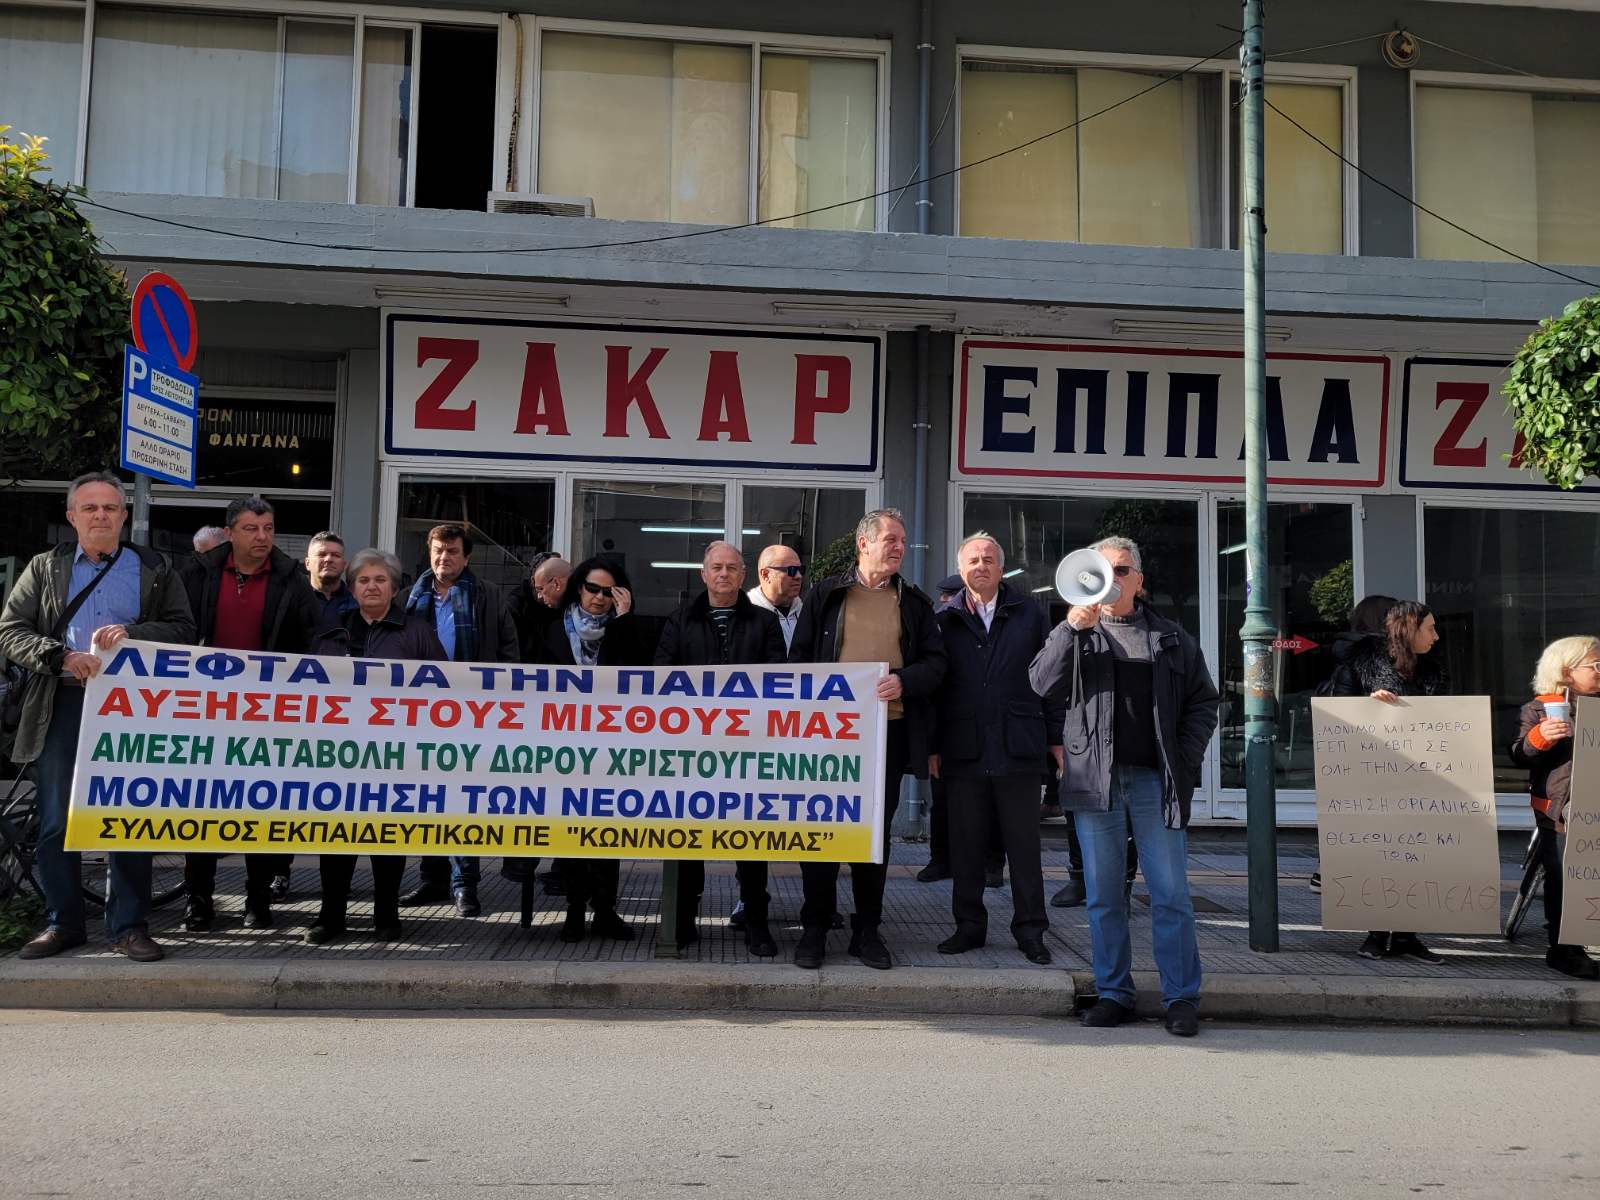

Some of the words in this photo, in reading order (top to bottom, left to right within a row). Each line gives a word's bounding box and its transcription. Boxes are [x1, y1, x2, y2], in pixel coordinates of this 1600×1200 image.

[128, 353, 148, 390] P
[151, 371, 194, 398] ΤΡΟΦΟΔΟΣΙΑ
[414, 336, 852, 445] ΖΑΚΑΡ
[980, 364, 1361, 464] ΕΠΙΠΛΑ
[140, 439, 158, 453] ΑΛΛΟ
[159, 445, 181, 460] ΩΡΑΡΙΟ
[209, 433, 300, 449] ΦΑΝΤΑΝΑ
[131, 450, 169, 470] ΠΡΟΣΩΡΙΝΗ
[169, 461, 187, 475] ΣΤΑΣΗ
[103, 647, 331, 685] ΛΕΦΤΑ
[353, 661, 451, 688] ΓΙΑ
[469, 667, 594, 694] ΤΗΝ
[617, 669, 856, 702] ΠΑΙΔΕΙΑ
[97, 687, 352, 725] ΑΥΞΗΣΕΙΣ
[367, 696, 525, 731] ΣΤΟΥΣ
[541, 702, 751, 737] ΜΙΣΘΟΥΣ
[766, 709, 861, 741] ΜΑΣ
[1384, 723, 1404, 734] ΚΑΙ
[1410, 721, 1473, 733] ΣΤΑΘΕΡΟ
[1581, 727, 1600, 748] Ν
[91, 732, 215, 766] ΑΜΕΣΗ
[225, 736, 406, 771] ΚΑΤΑΒΟΛΗ
[416, 742, 482, 773] ΤΟΥ
[489, 744, 599, 776] ΔΩΡΟΥ
[606, 747, 861, 783] ΧΡΙΣΤΟΥΓΕΝΝΩΝ
[1360, 740, 1378, 752] ΚΑΙ
[1426, 740, 1449, 753] ΣΕ
[1321, 763, 1352, 777] ΟΛΗ
[1360, 760, 1399, 774] ΤΗΝ
[87, 775, 447, 814] ΜΟΝΙΜΟΠΟΙΗΣΗ
[461, 785, 547, 817] ΤΩΝ
[561, 786, 862, 823] ΝΕΟΔΙΟΡΙΣΤΩΝ
[1327, 797, 1389, 813] ΑΥΞΗΣΗ
[1397, 797, 1492, 814] ΟΡΓΑΝΙΚΩΝ
[99, 816, 259, 842] ΣΥΛΛΟΓΟΣ
[267, 819, 505, 847] ΕΚΠΑΙΔΕΥΤΙΚΩΝ
[513, 825, 550, 847] ΠΕ
[567, 825, 703, 850] "ΚΩΝ/ΝΟΣ
[1326, 832, 1392, 846] ΘΕΣΕΩΝ
[1398, 831, 1430, 845] ΕΔΩ
[1436, 832, 1462, 846] ΚΑΙ
